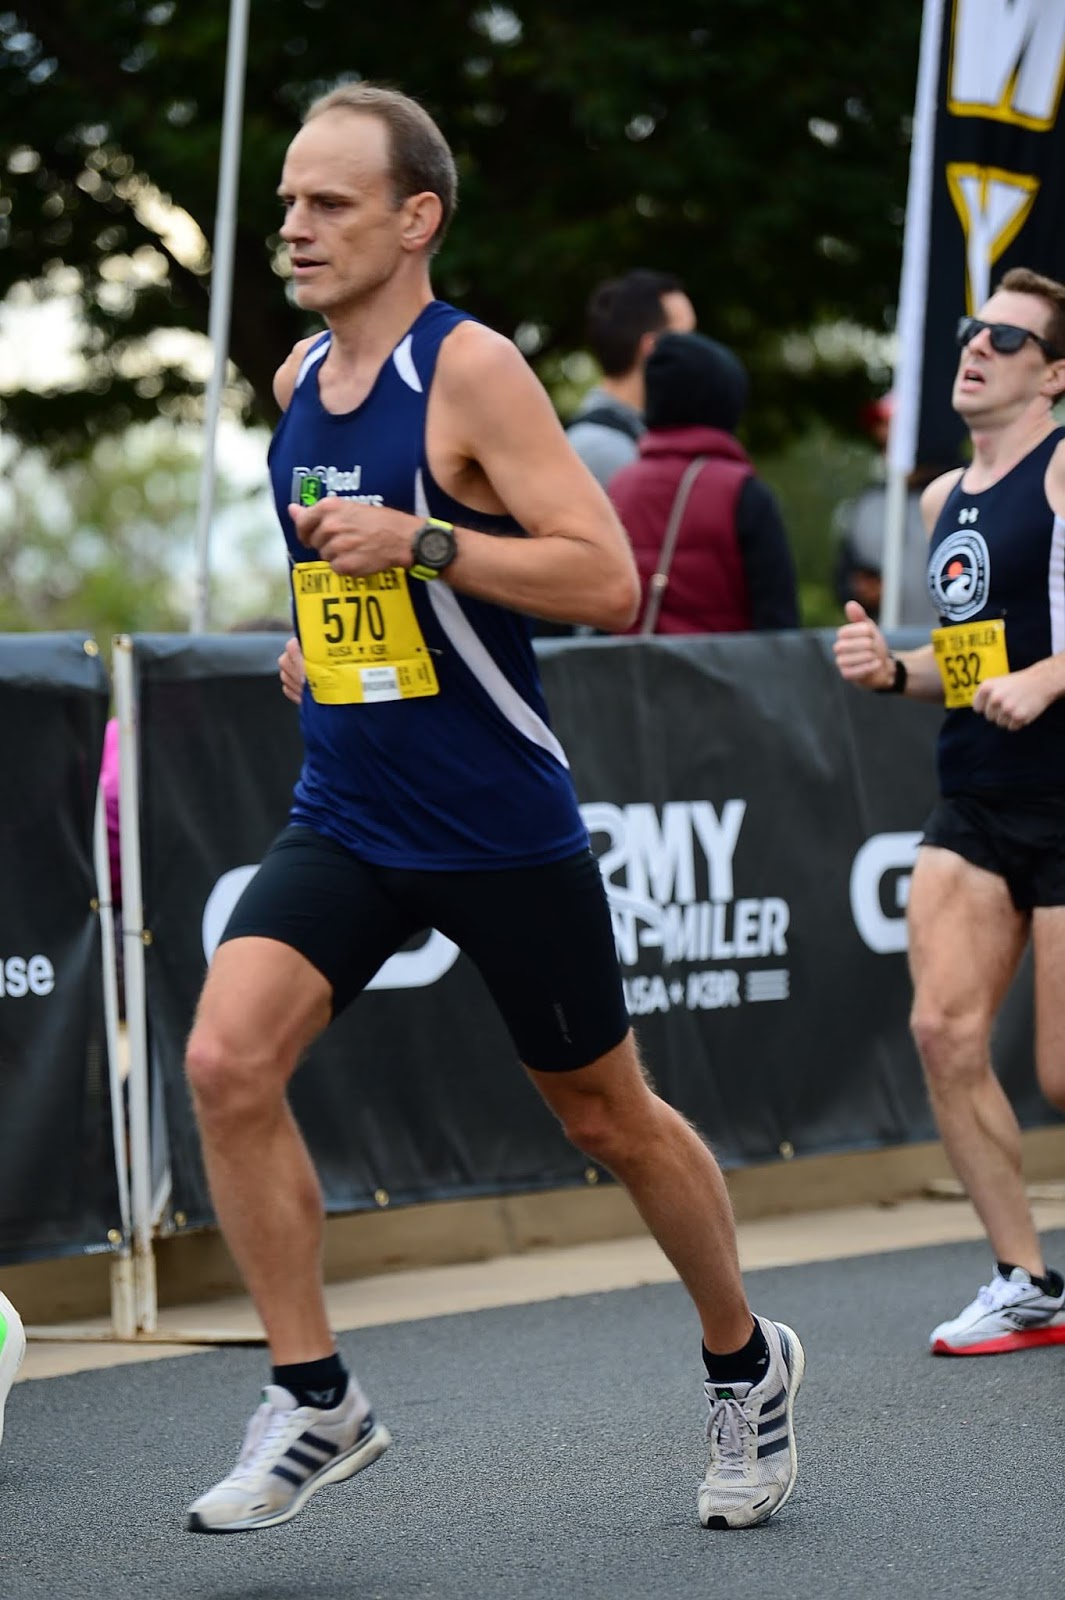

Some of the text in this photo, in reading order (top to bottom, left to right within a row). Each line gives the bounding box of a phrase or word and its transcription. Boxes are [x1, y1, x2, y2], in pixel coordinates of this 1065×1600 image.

[322, 595, 385, 644] 570
[944, 652, 982, 689] 532
[578, 798, 748, 905] RMY
[609, 897, 790, 966] N-MILER
[0, 954, 55, 998] se
